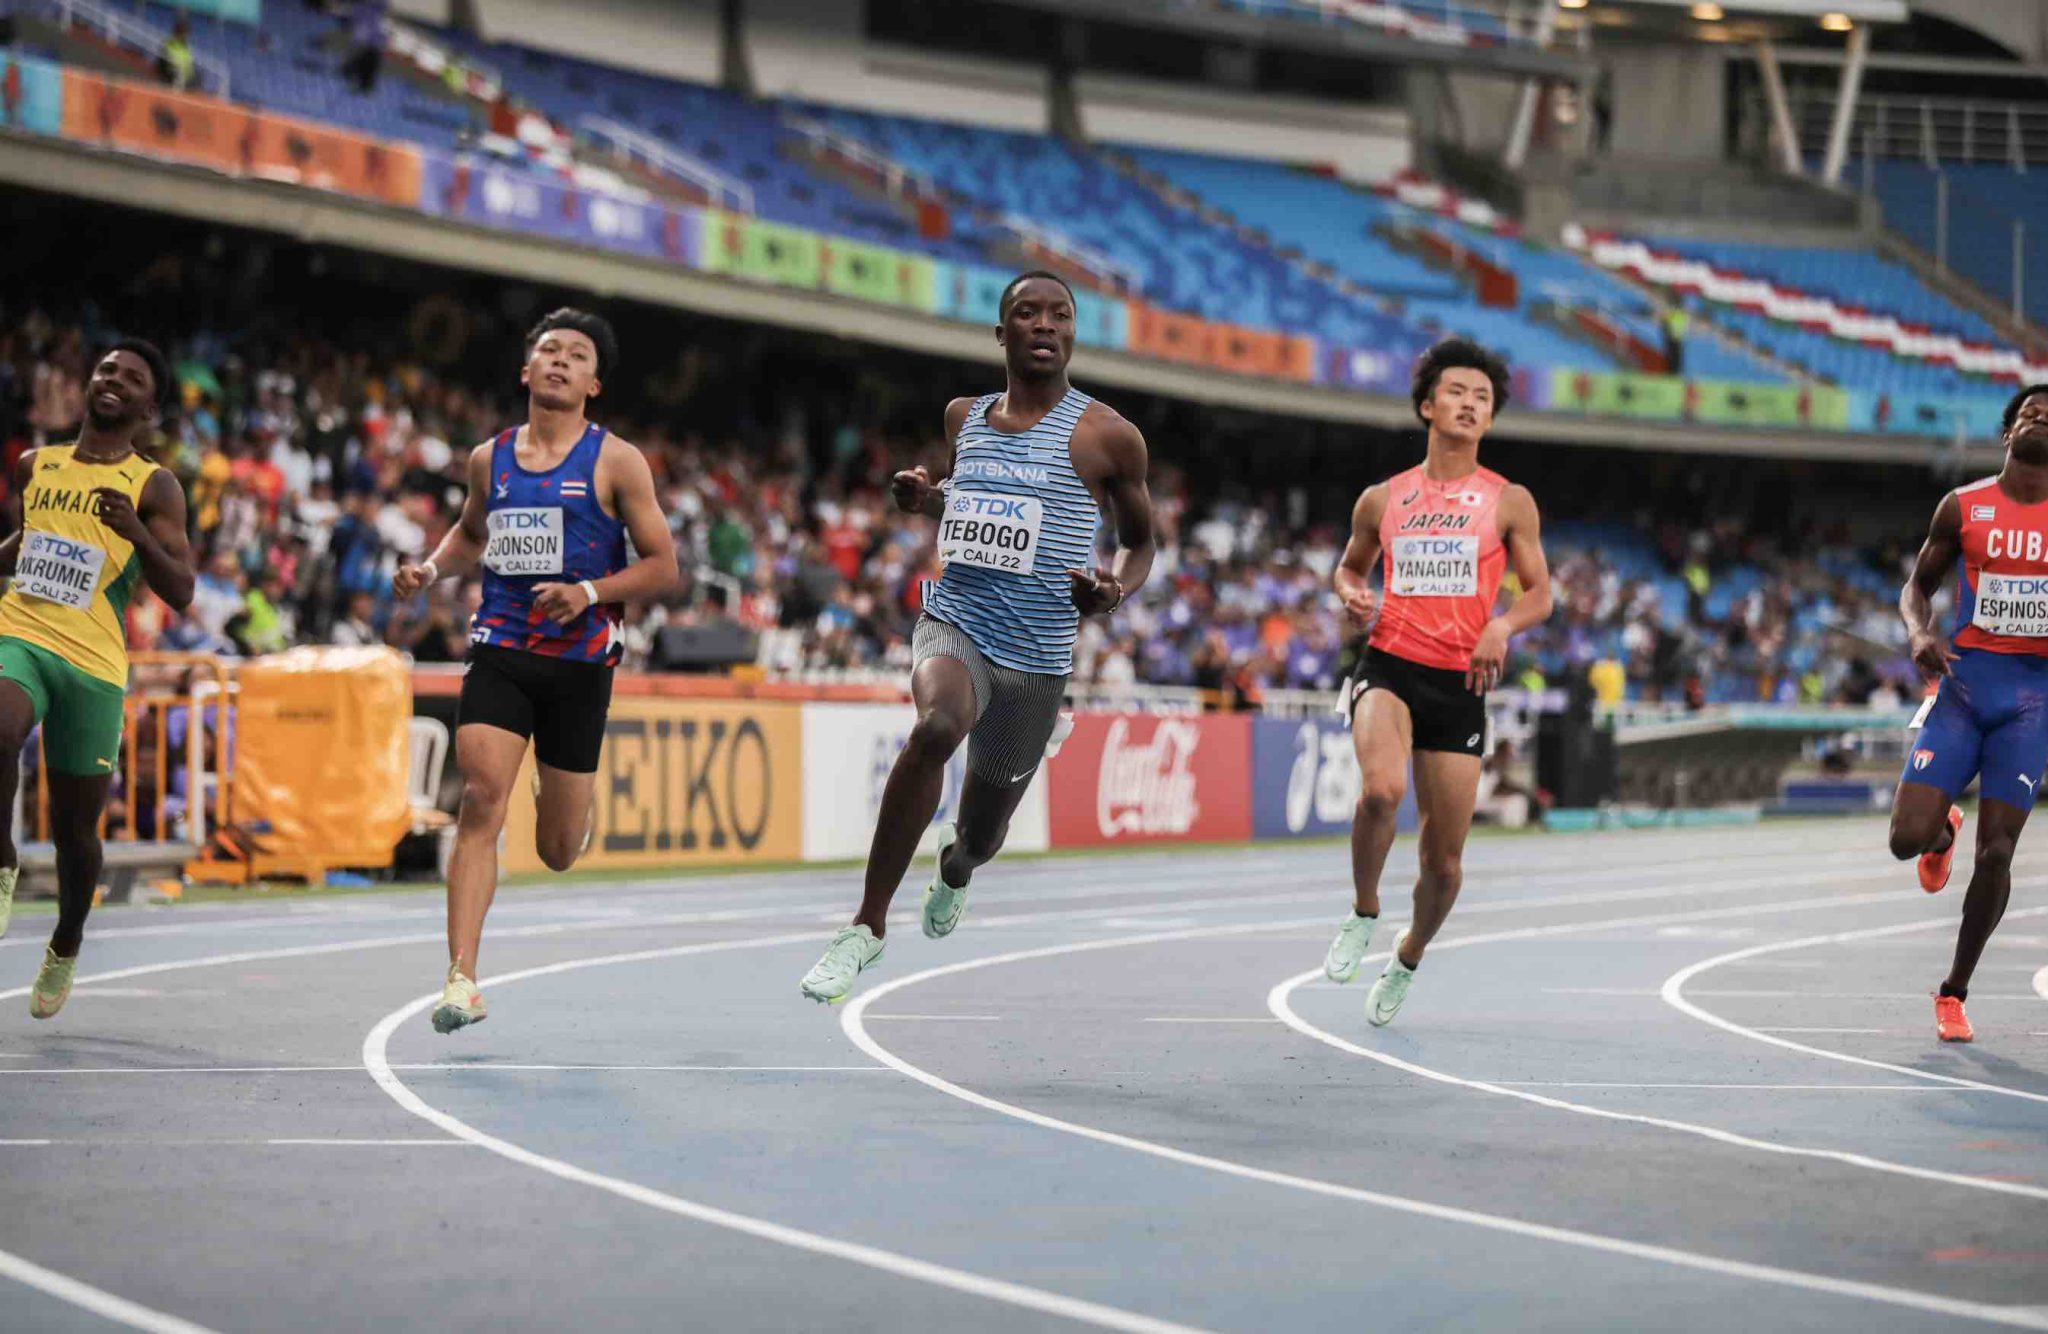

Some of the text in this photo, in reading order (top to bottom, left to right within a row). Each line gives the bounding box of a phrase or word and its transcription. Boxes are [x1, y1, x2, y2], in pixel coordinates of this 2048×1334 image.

[956, 461, 1048, 482] BOTSWANA
[29, 487, 102, 516] JAMAIC
[972, 497, 1028, 521] TDK
[503, 512, 549, 528] TDK
[1401, 513, 1470, 530] JAPAN
[943, 519, 1030, 552] TEBOGO
[44, 537, 91, 565] TDK
[963, 548, 1021, 569] CALI 22
[1417, 541, 1464, 555] TDK
[506, 560, 552, 572] CALI 22
[1397, 560, 1472, 578] YANAGITA
[31, 582, 80, 605] CALI 22
[1421, 583, 1467, 593] CALI 22
[2003, 580, 2048, 595] TDK
[1980, 598, 2048, 619] ESPINOS
[2006, 623, 2034, 634] CALI
[590, 718, 772, 850] EIKO
